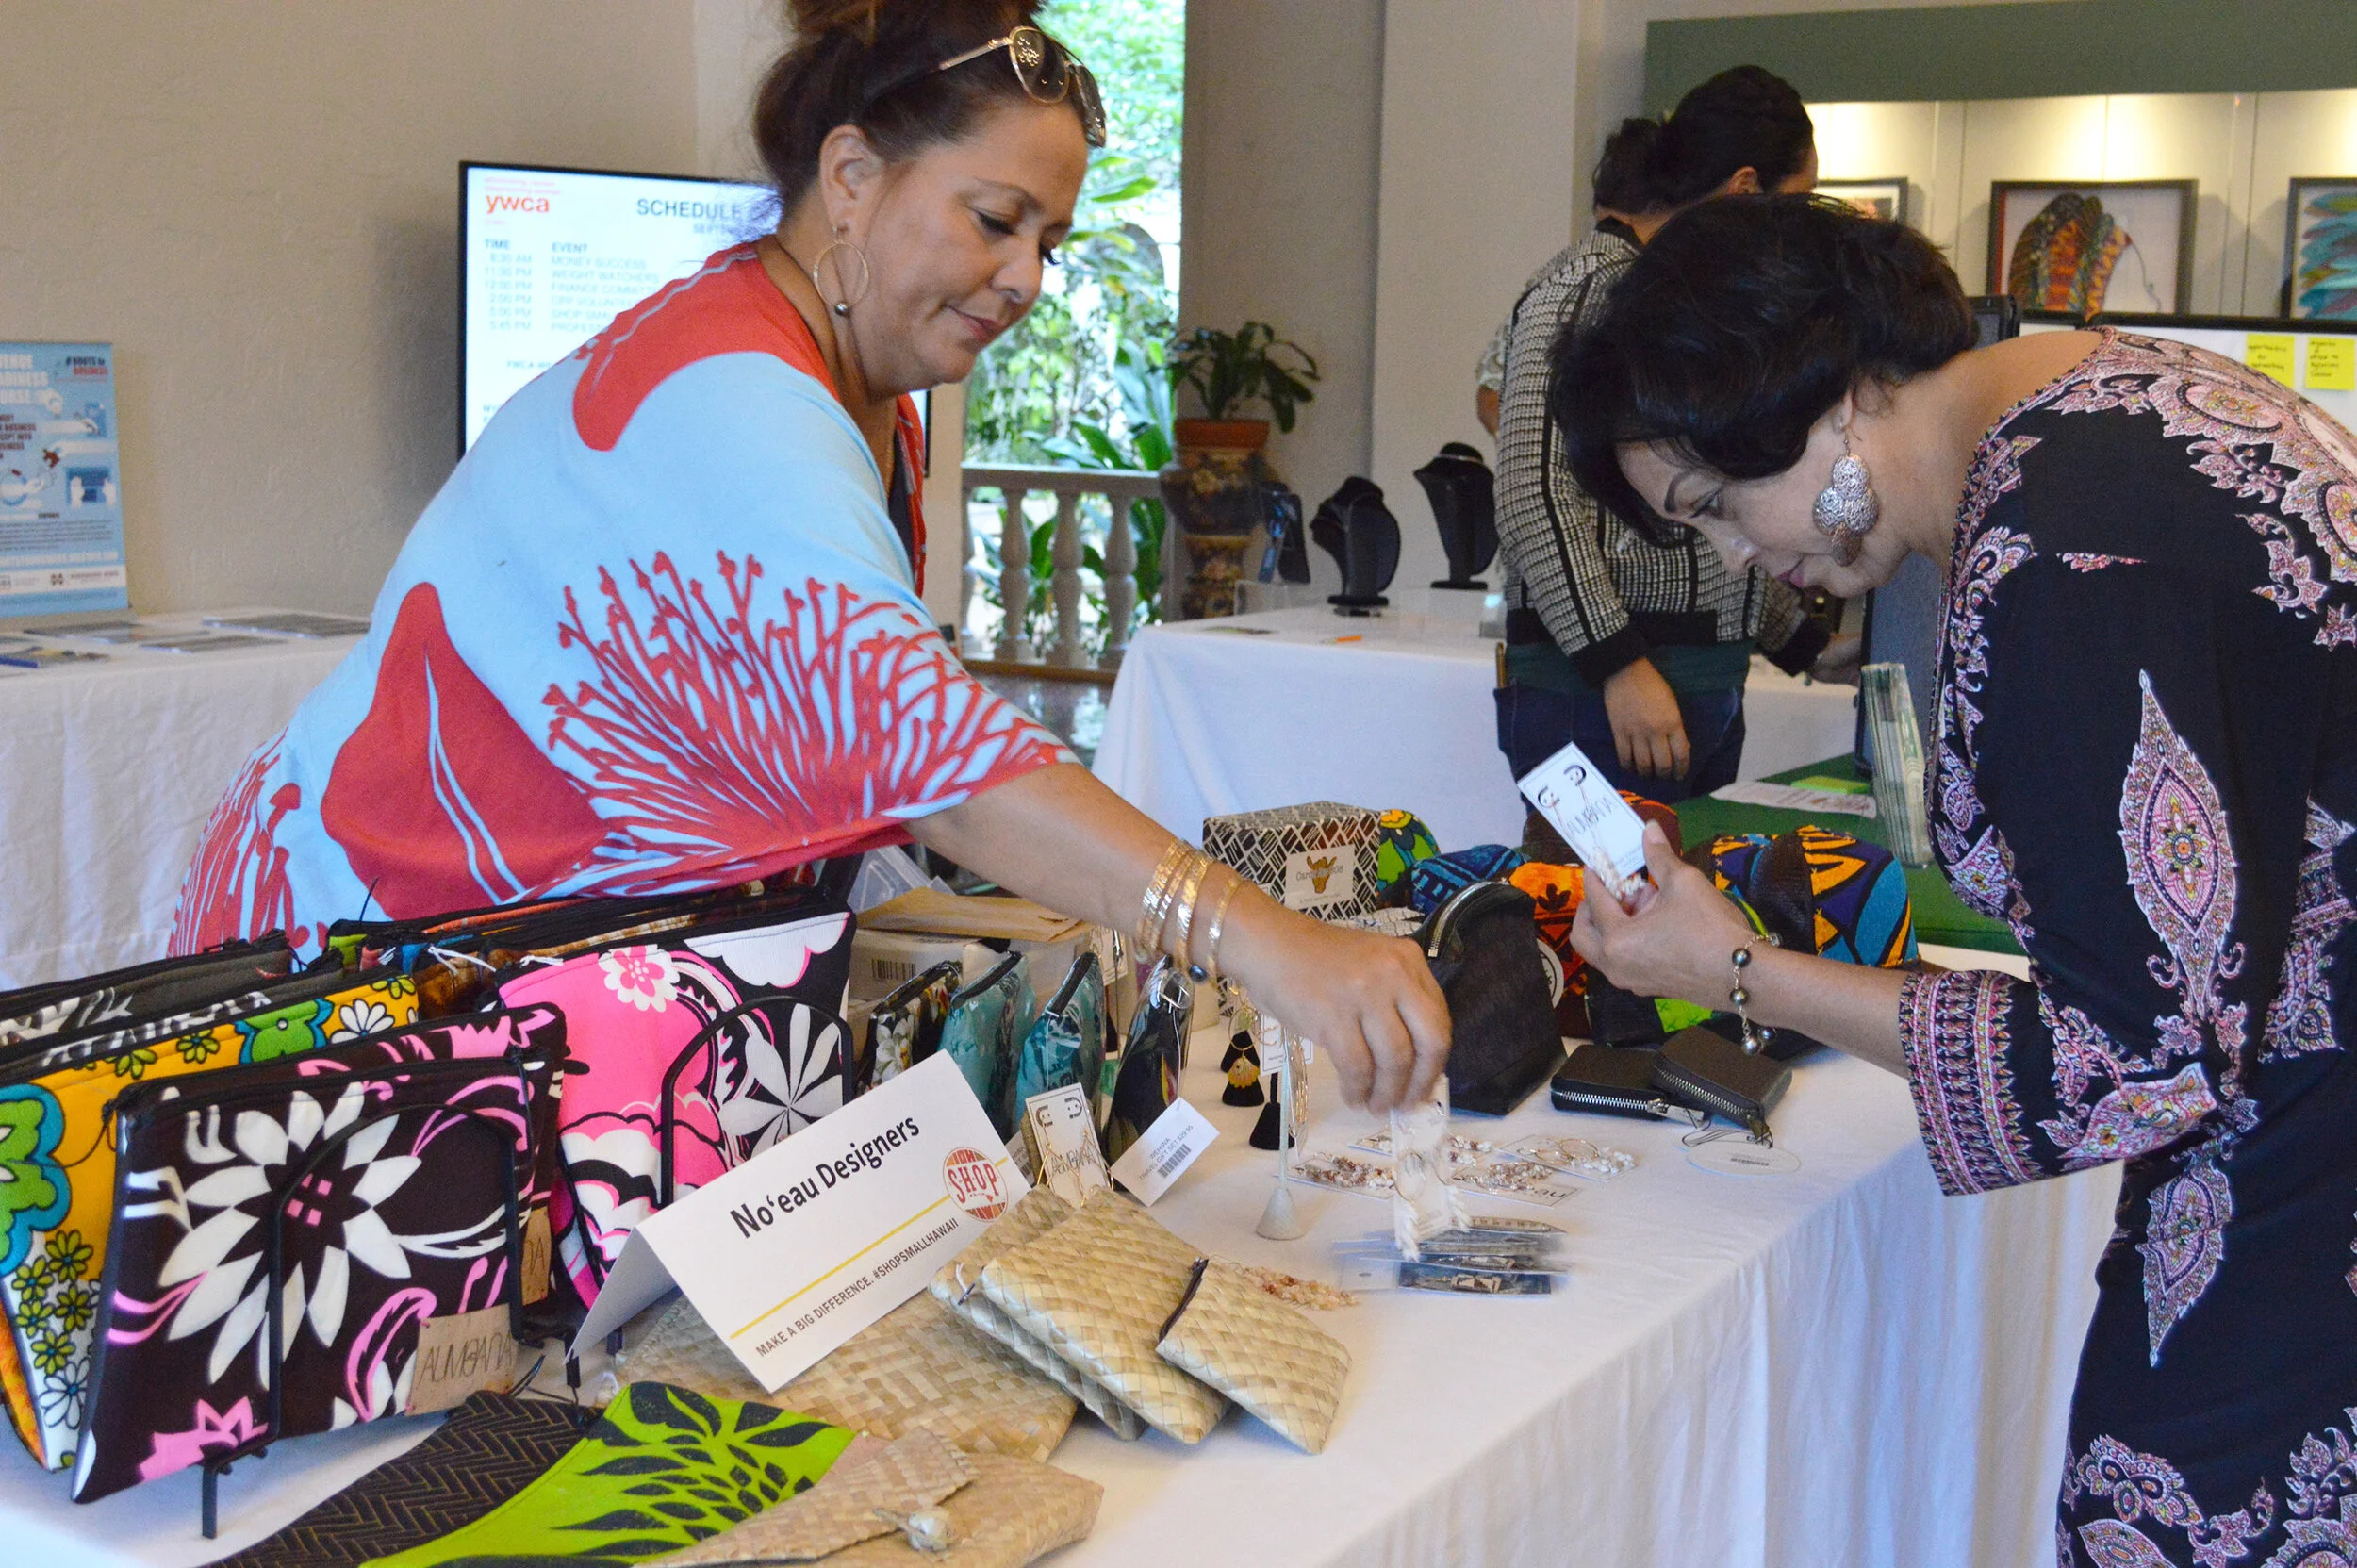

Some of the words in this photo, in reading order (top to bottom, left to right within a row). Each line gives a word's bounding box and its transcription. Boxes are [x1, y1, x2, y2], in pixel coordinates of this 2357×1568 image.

[486, 195, 550, 214] ywca
[485, 239, 510, 250] TIME
[552, 242, 588, 253] EVENT
[816, 1117, 920, 1188] Designers
[948, 1164, 998, 1203] SHOP
[755, 1330, 789, 1358] MAKE
[786, 1327, 798, 1337] A
[794, 1314, 816, 1332] BIG
[813, 1276, 875, 1320] DIFFERENCE.
[872, 1217, 960, 1279] #SHOPSMALLHAWAII
